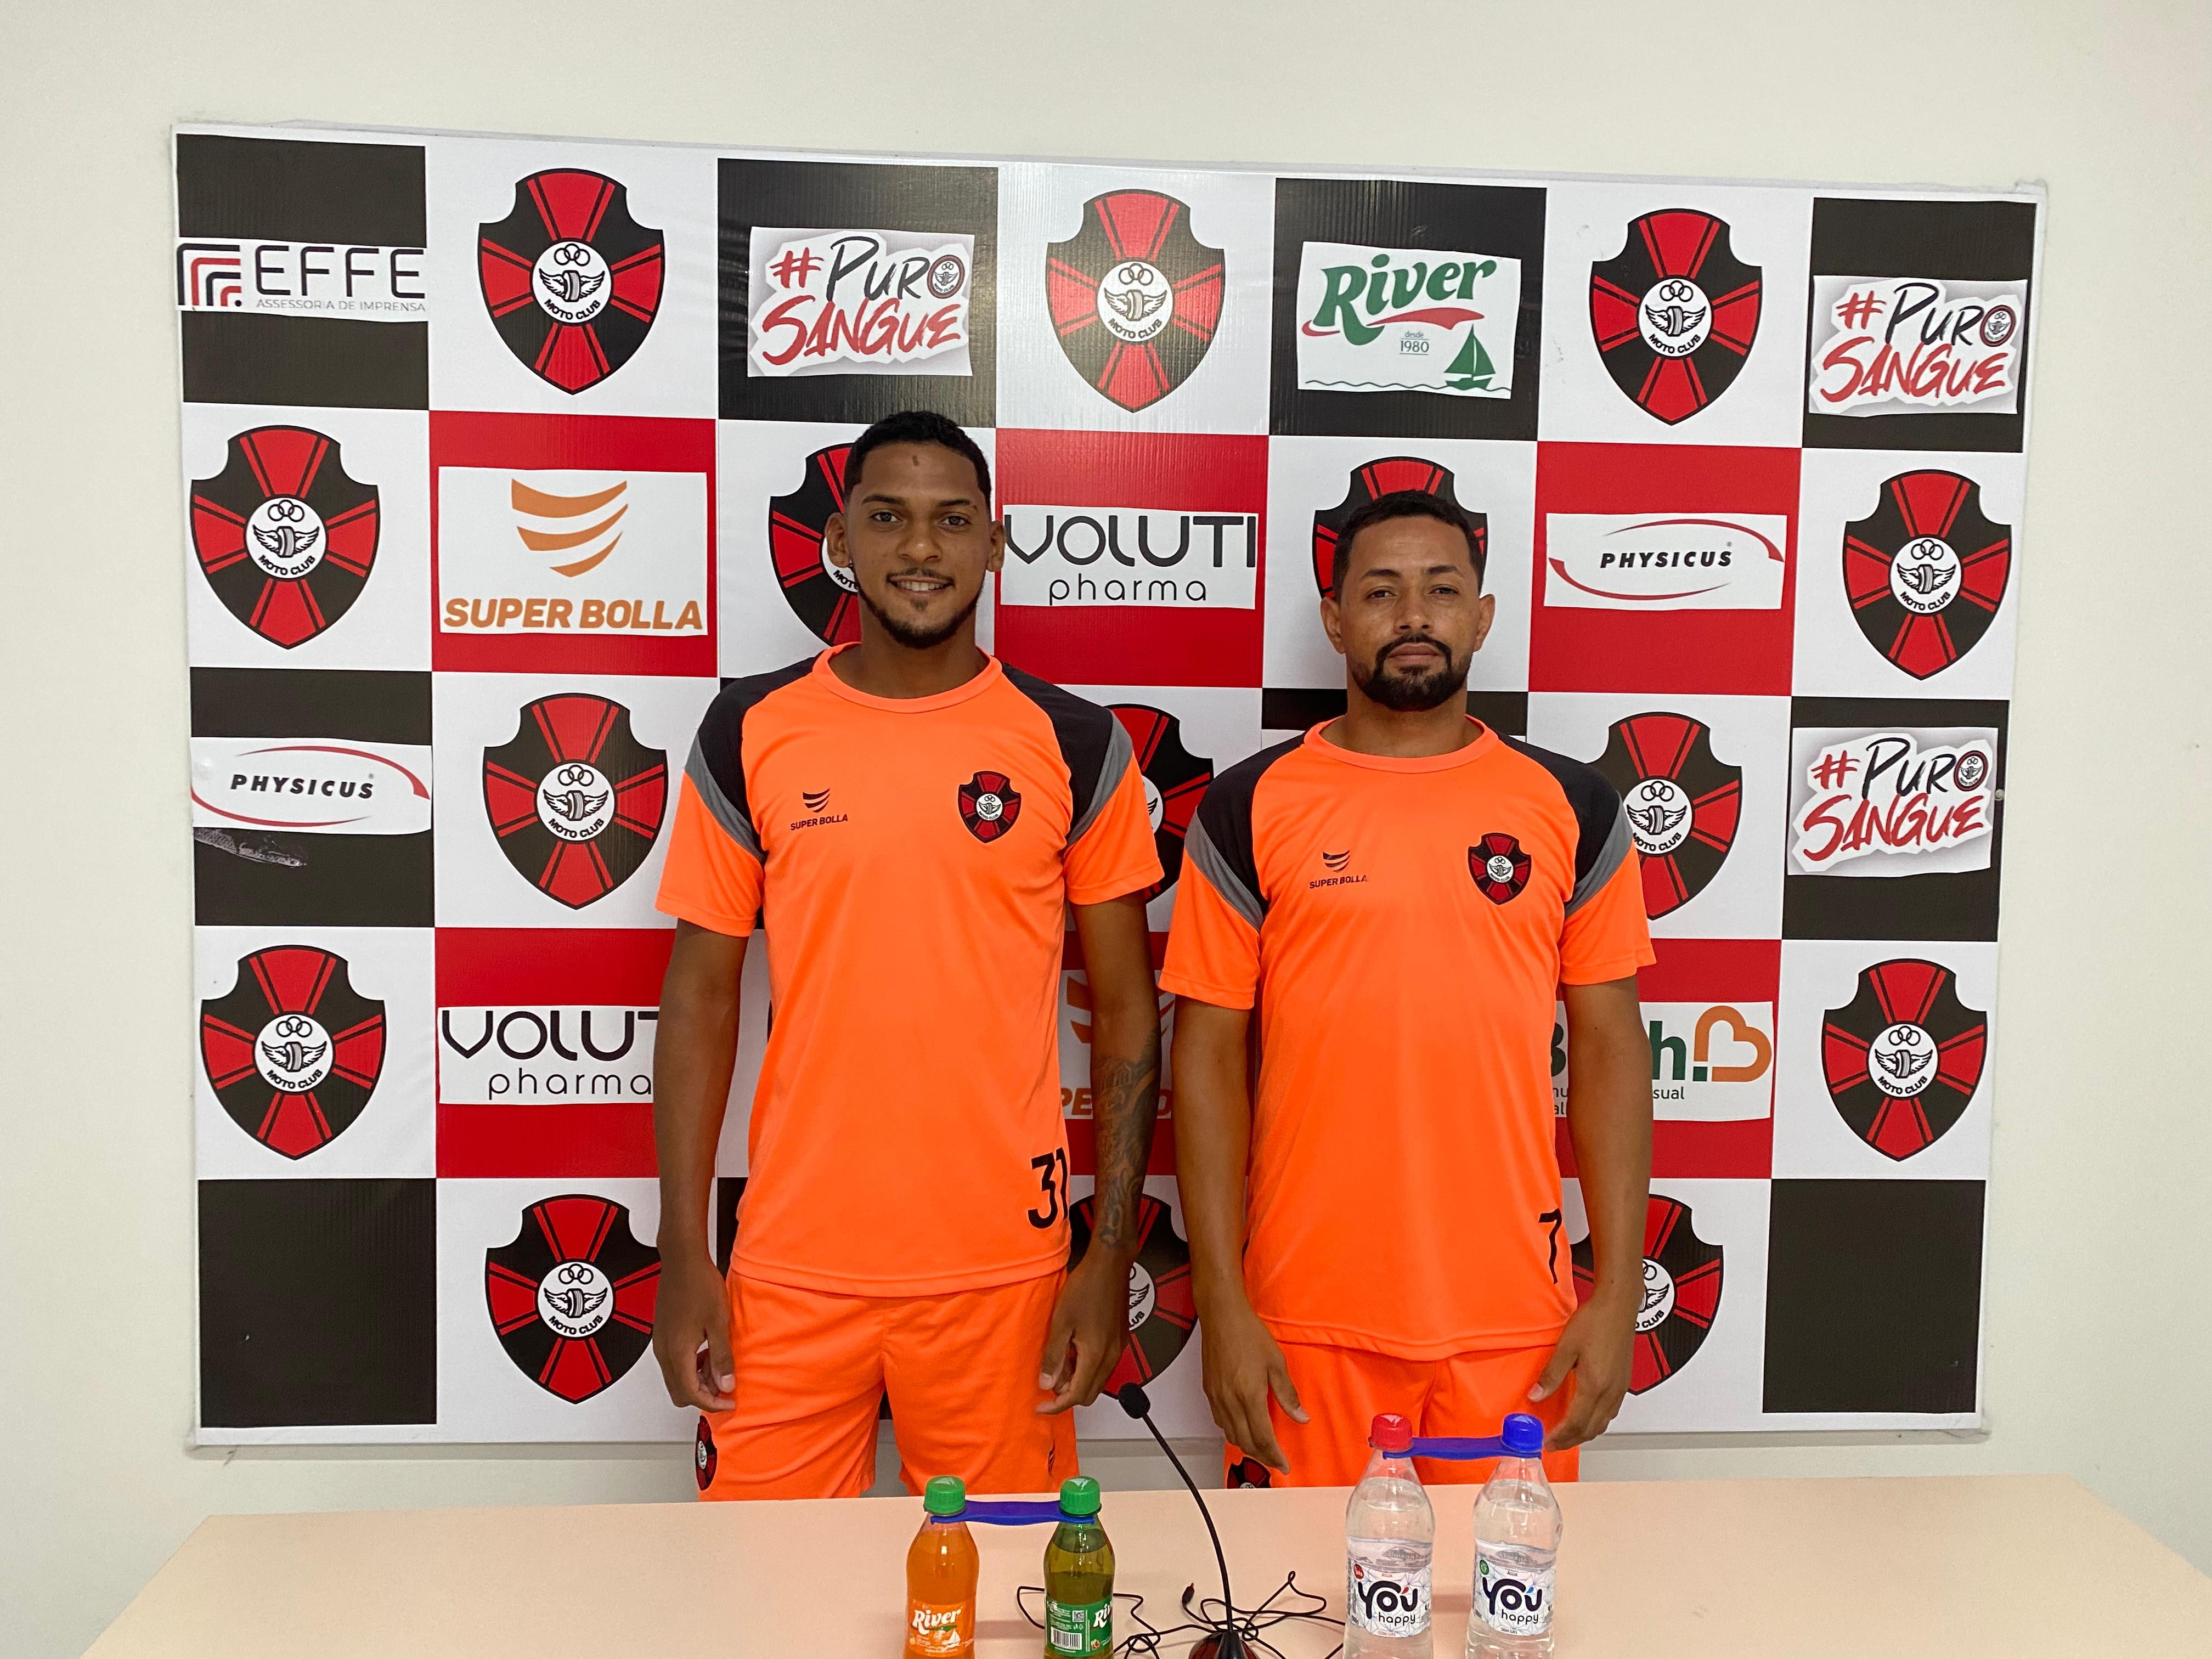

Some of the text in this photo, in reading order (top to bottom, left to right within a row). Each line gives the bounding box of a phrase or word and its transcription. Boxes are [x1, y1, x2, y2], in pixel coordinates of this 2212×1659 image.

[255, 245, 425, 299] EFFE
[256, 299, 426, 312] ASSESSORIA DE IMPRENSA
[544, 299, 601, 320] MOTO CLUB
[1312, 253, 1497, 346] River
[1108, 318, 1162, 338] MOTO CLUB
[1400, 340, 1429, 352] 1980
[1649, 334, 1701, 353] MOTO CLUB
[1004, 514, 1256, 568] VOLUTI
[258, 555, 315, 575] MOTO CLUB
[1600, 551, 1733, 568] PHYSICUS
[1049, 573, 1207, 606] pharma
[1900, 591, 1951, 610] MOTO CLUB
[443, 598, 703, 630] SUPER BOLLA
[230, 774, 374, 799] PHYSICUS
[548, 818, 604, 838] MOTO CLUB
[790, 814, 848, 831] SUPER BOLLA
[1633, 832, 1682, 851] MOTO CLUB
[1309, 874, 1367, 889] SUPER BOLLA
[442, 1010, 659, 1062] VOLU
[267, 1069, 323, 1089] MOTO CLUB
[489, 1068, 652, 1101] pharma
[1877, 1075, 1928, 1094] MOTO CLUB
[1027, 1147, 1070, 1229] 31
[1538, 1207, 1562, 1285] 7
[549, 1314, 603, 1335] MOTO CLUB
[1641, 1310, 1664, 1328] CLUB
[912, 1609, 962, 1635] River
[1378, 1611, 1416, 1627] happy
[1501, 1609, 1539, 1626] happy
